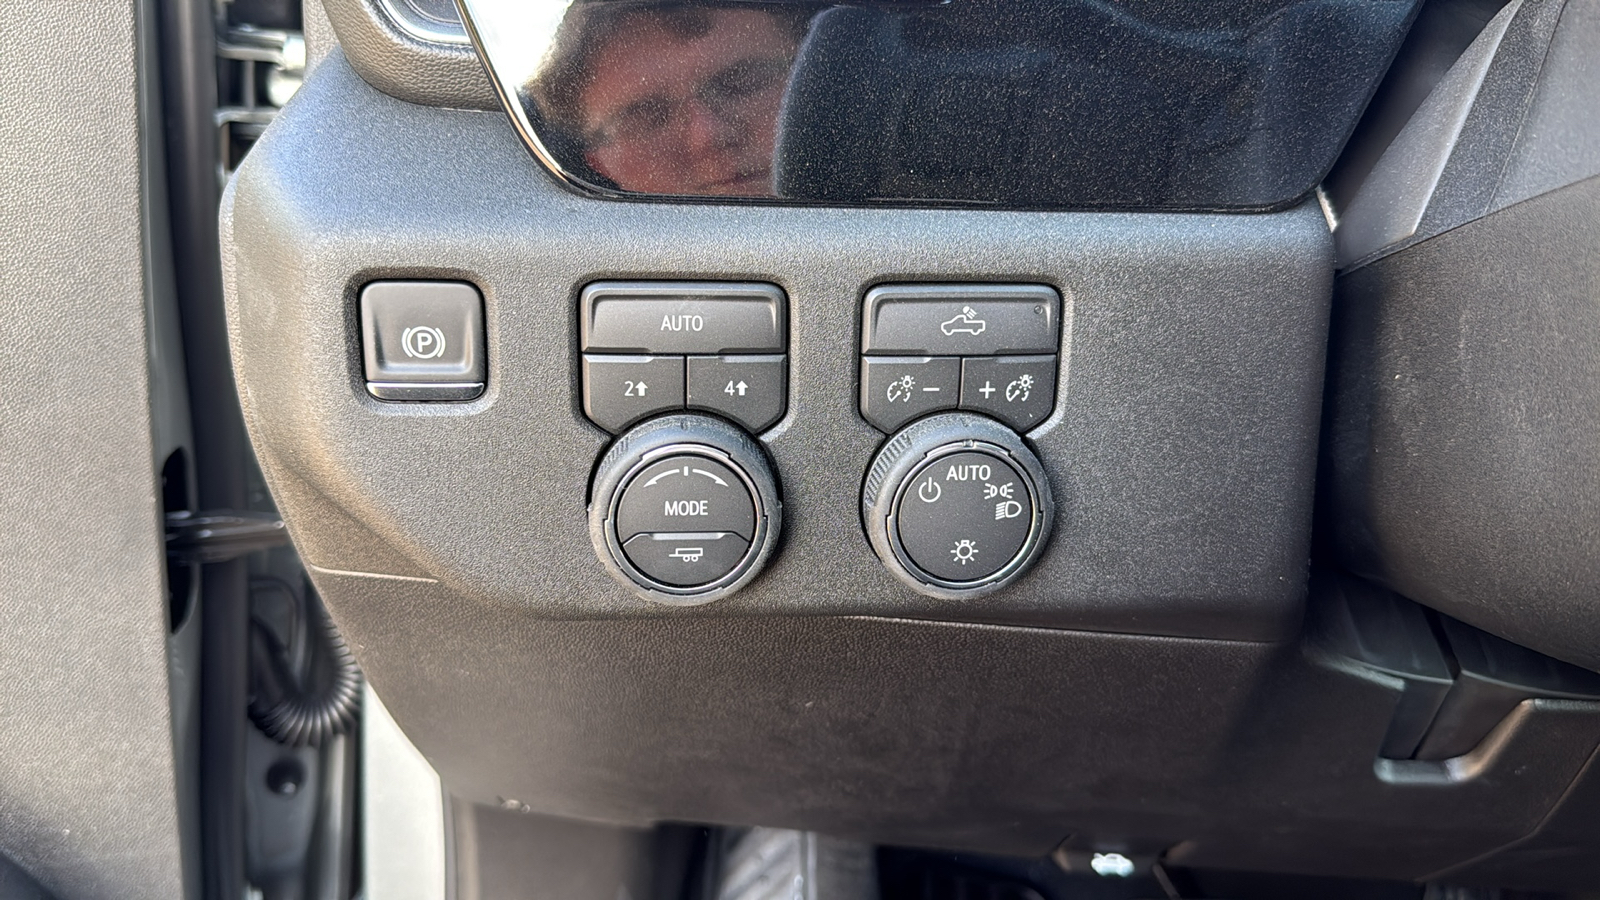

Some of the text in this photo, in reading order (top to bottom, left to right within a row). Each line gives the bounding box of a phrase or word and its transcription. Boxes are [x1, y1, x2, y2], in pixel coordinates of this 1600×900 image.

[660, 315, 704, 331] AUTO
[417, 333, 432, 352] P
[624, 381, 634, 396] 2
[724, 381, 735, 396] 4
[946, 465, 991, 481] AUTO
[664, 500, 708, 516] MODE
